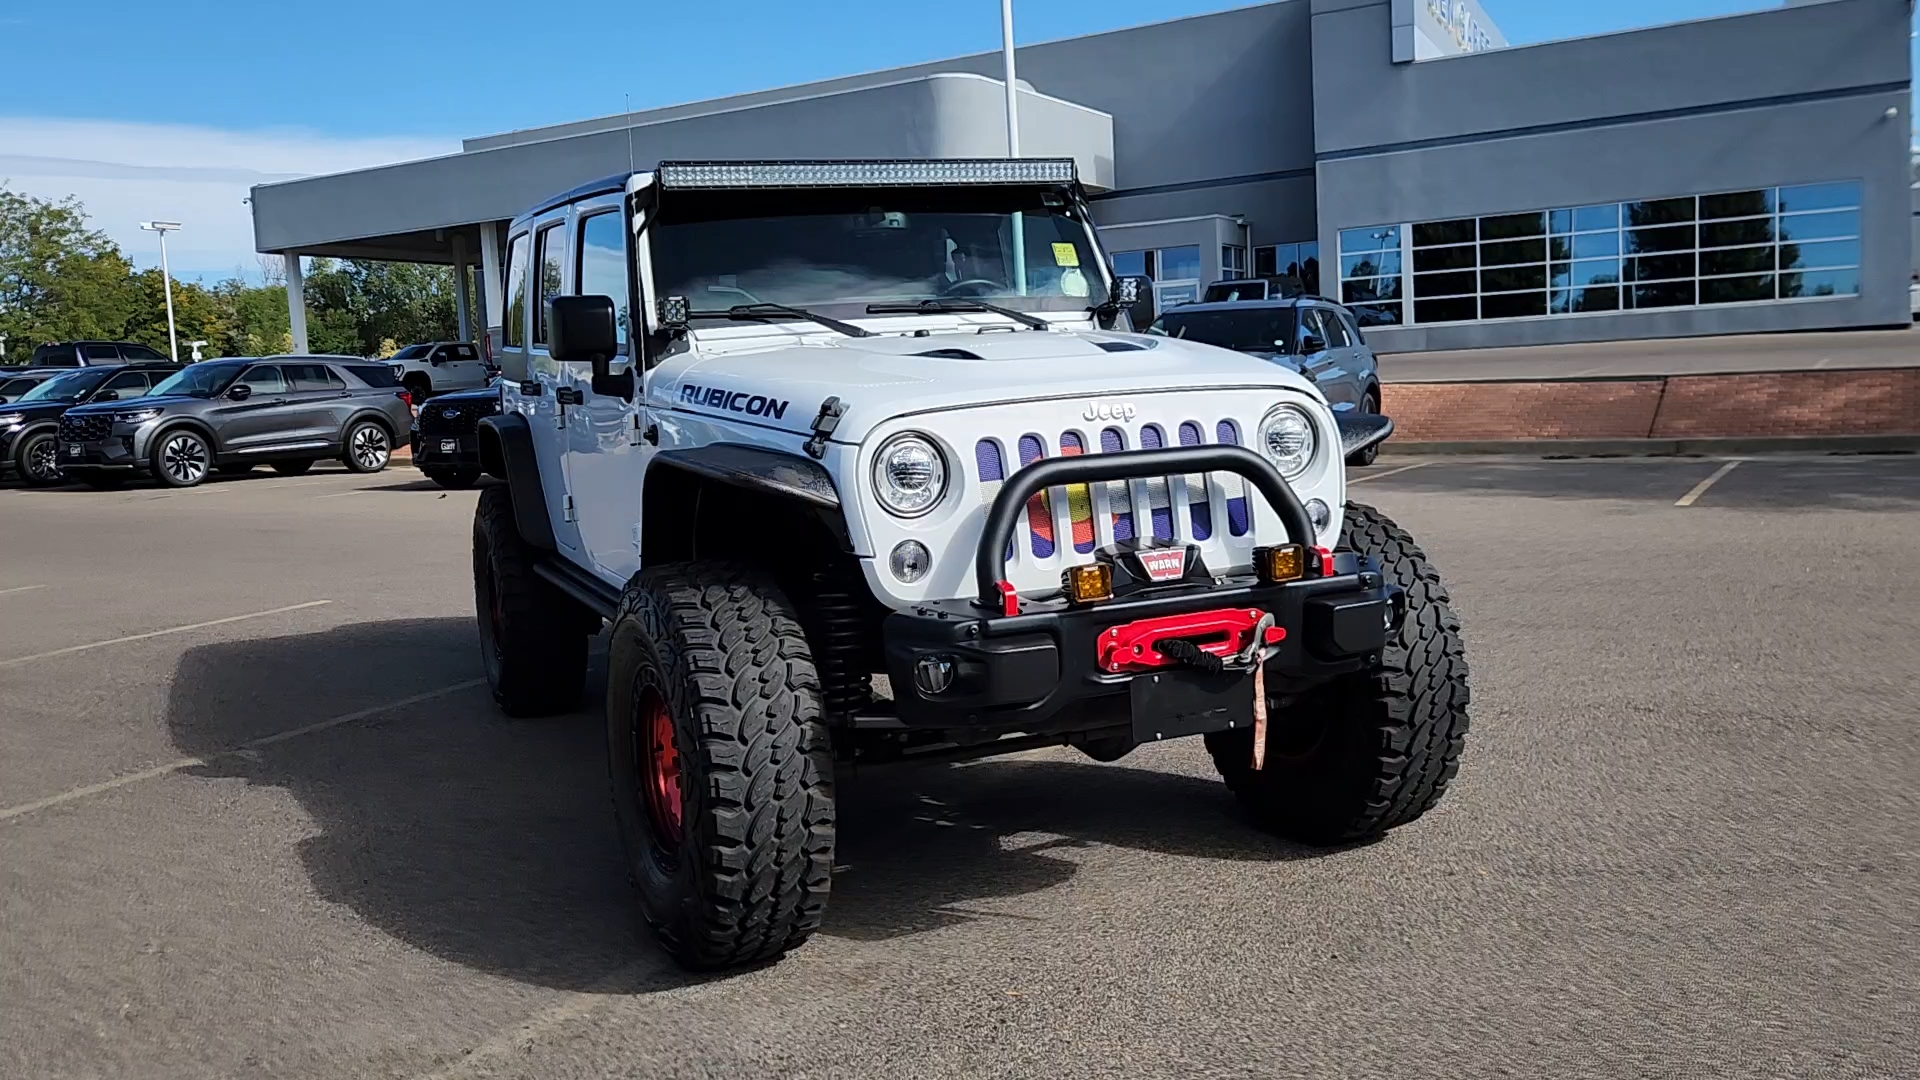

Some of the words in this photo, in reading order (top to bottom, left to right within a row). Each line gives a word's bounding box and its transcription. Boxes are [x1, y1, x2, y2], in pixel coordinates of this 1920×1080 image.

[680, 384, 789, 420] RUBICON
[1082, 401, 1136, 423] Jeep
[1148, 558, 1180, 571] WARN
